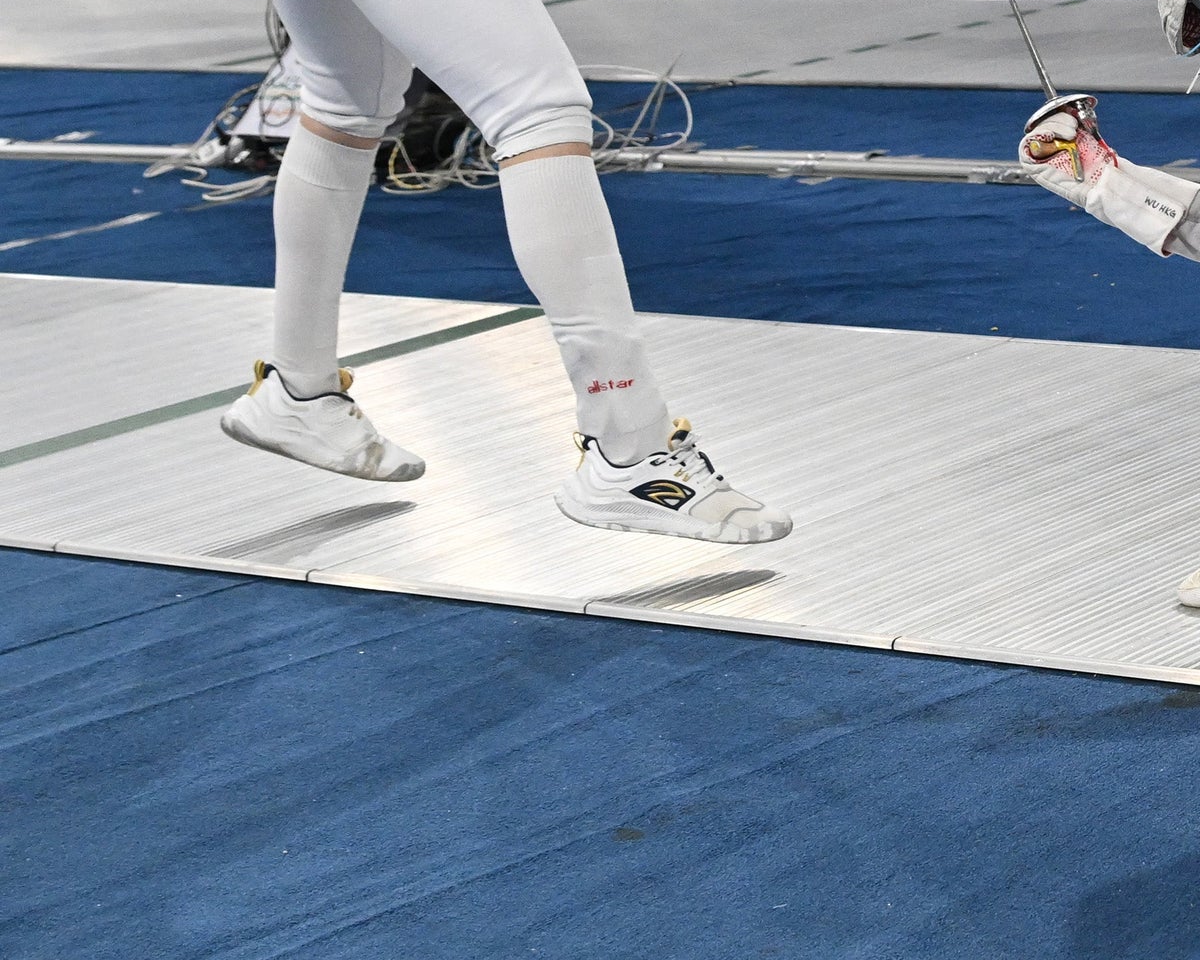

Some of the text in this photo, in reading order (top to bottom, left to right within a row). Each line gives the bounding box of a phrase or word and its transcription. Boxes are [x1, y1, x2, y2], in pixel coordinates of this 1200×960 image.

[1144, 196, 1177, 218] WU HKG
[587, 379, 635, 394] allstar
